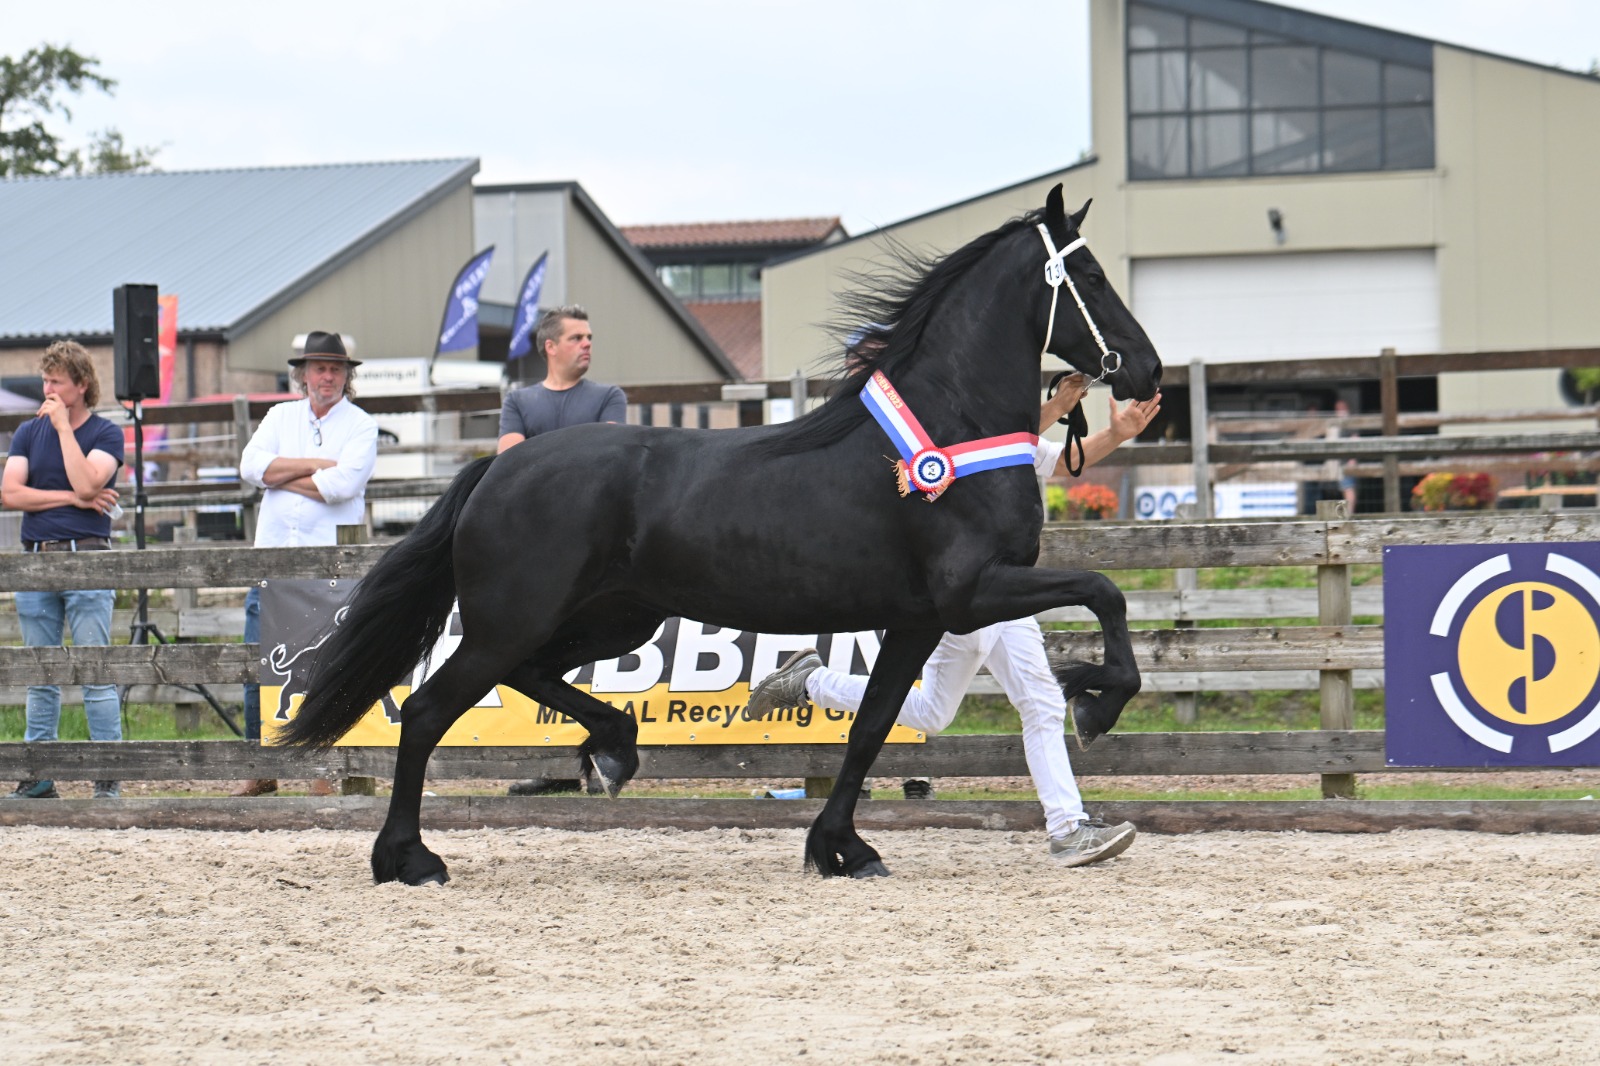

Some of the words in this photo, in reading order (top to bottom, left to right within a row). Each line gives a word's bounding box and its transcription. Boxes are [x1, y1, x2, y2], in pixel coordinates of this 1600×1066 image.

[886, 390, 904, 409] 2023
[536, 700, 657, 725] MAL
[667, 700, 814, 728] Recycng
